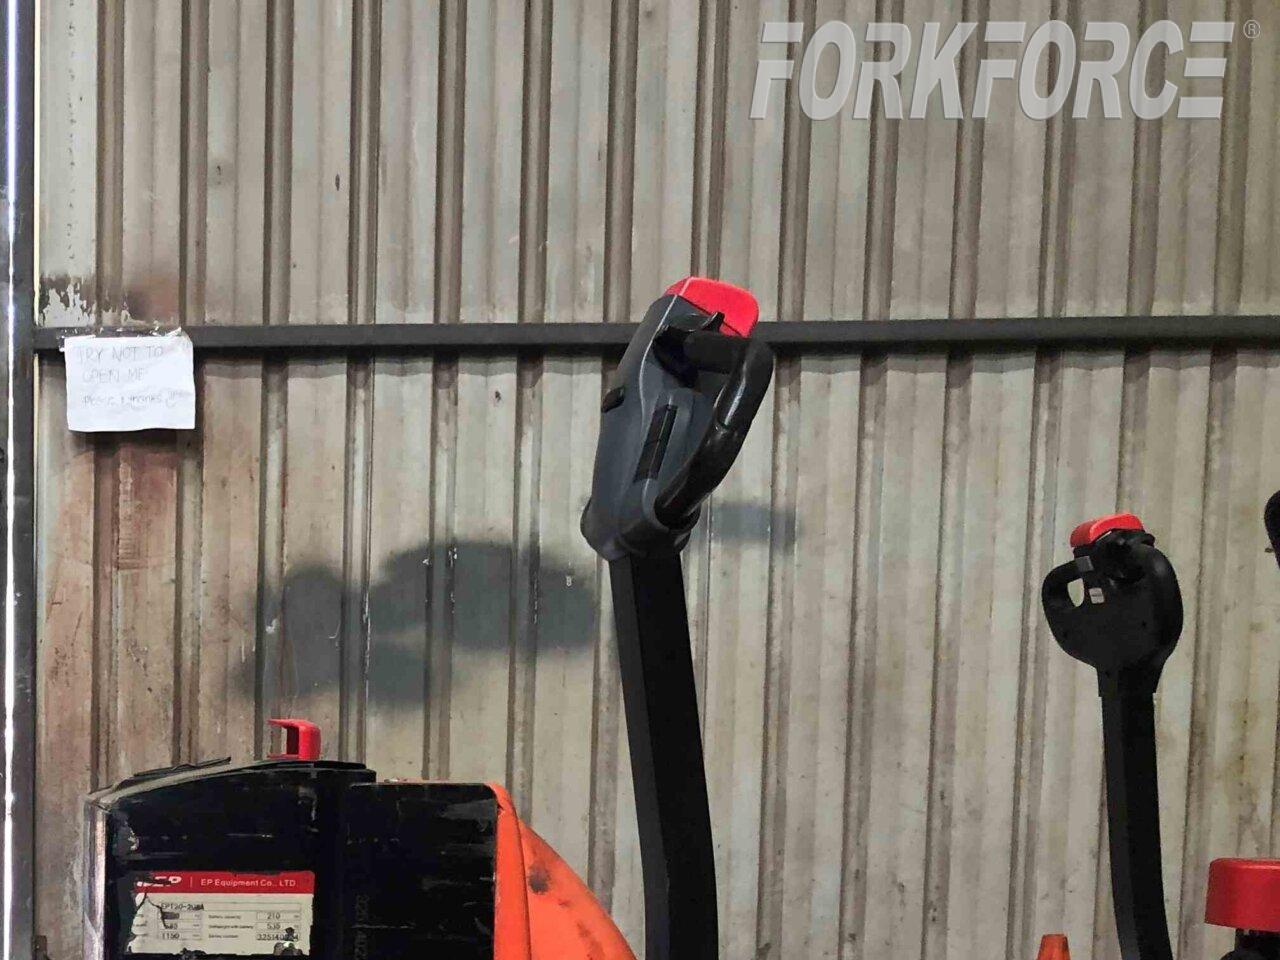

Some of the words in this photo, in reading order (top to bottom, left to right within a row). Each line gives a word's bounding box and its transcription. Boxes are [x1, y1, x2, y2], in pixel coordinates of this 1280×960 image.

[112, 346, 137, 361] NOT
[214, 878, 259, 888] Equipment
[279, 879, 297, 887] LTD
